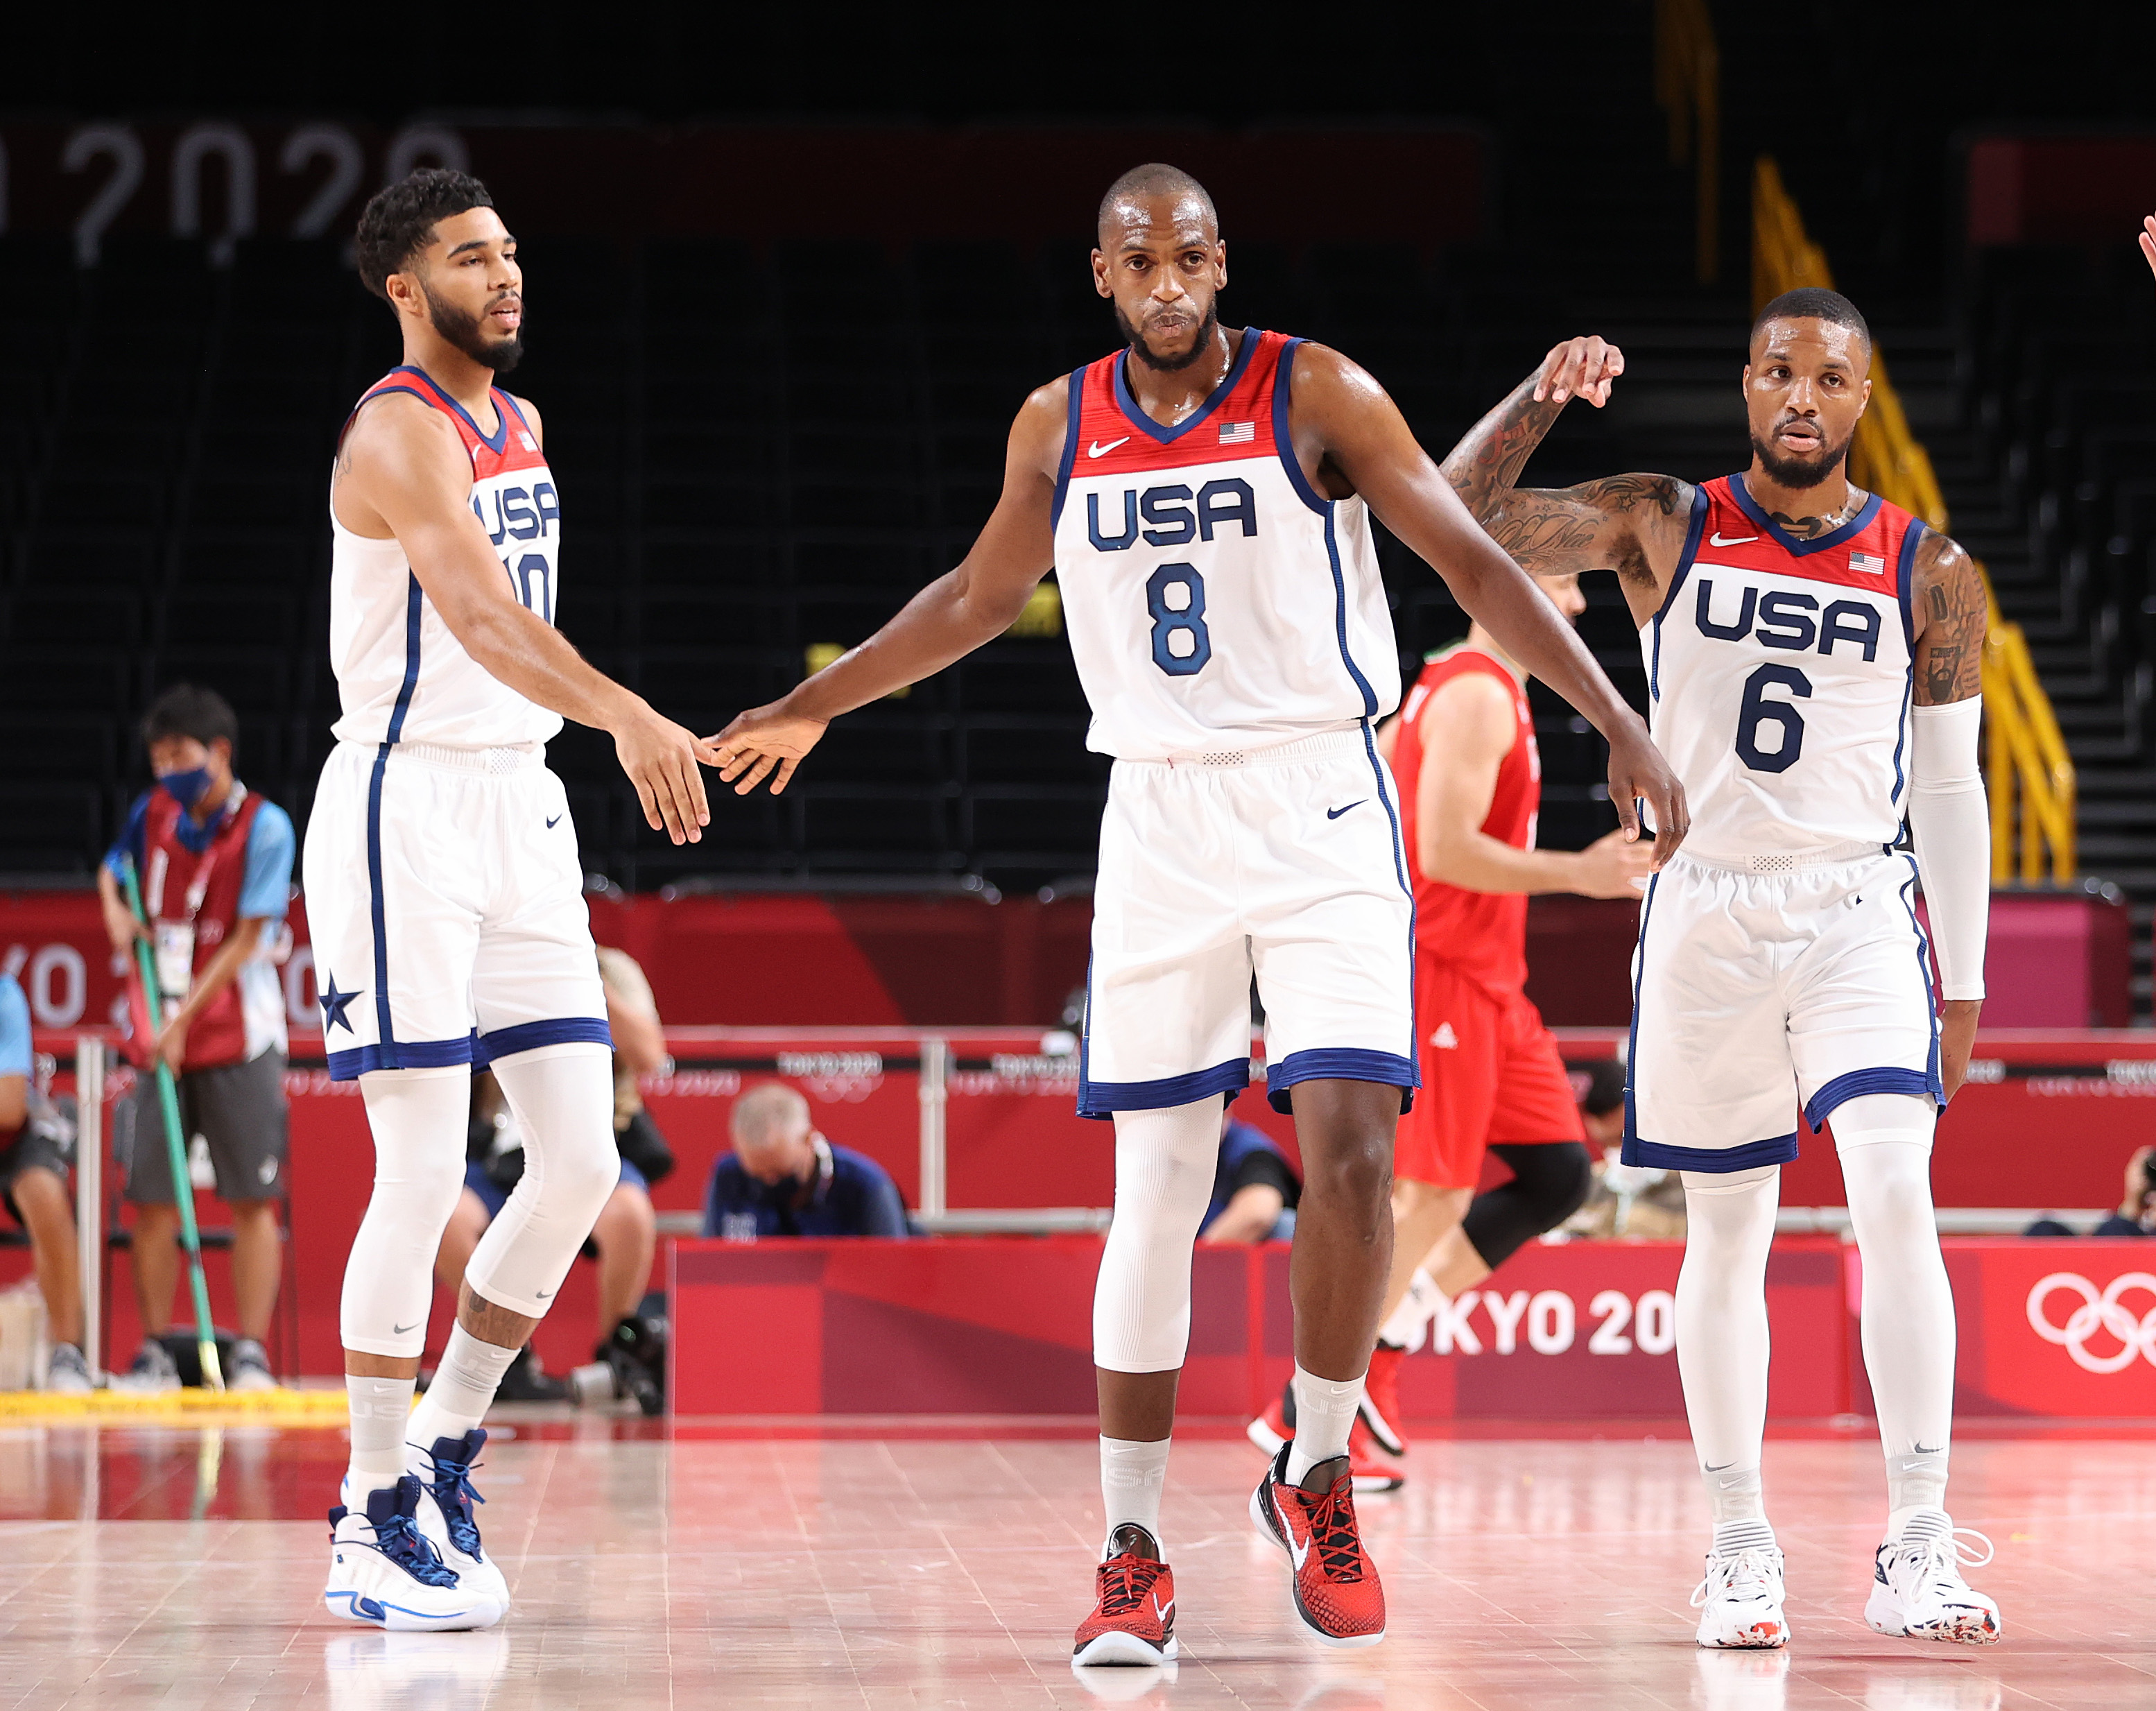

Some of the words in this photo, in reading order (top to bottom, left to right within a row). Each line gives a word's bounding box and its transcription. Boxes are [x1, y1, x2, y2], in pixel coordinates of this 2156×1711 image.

[473, 483, 560, 546] USA
[1087, 477, 1258, 552] USA
[503, 554, 551, 625] 0
[1146, 562, 1211, 677] 8
[1696, 578, 1881, 662] USA
[1735, 662, 1813, 774] 6
